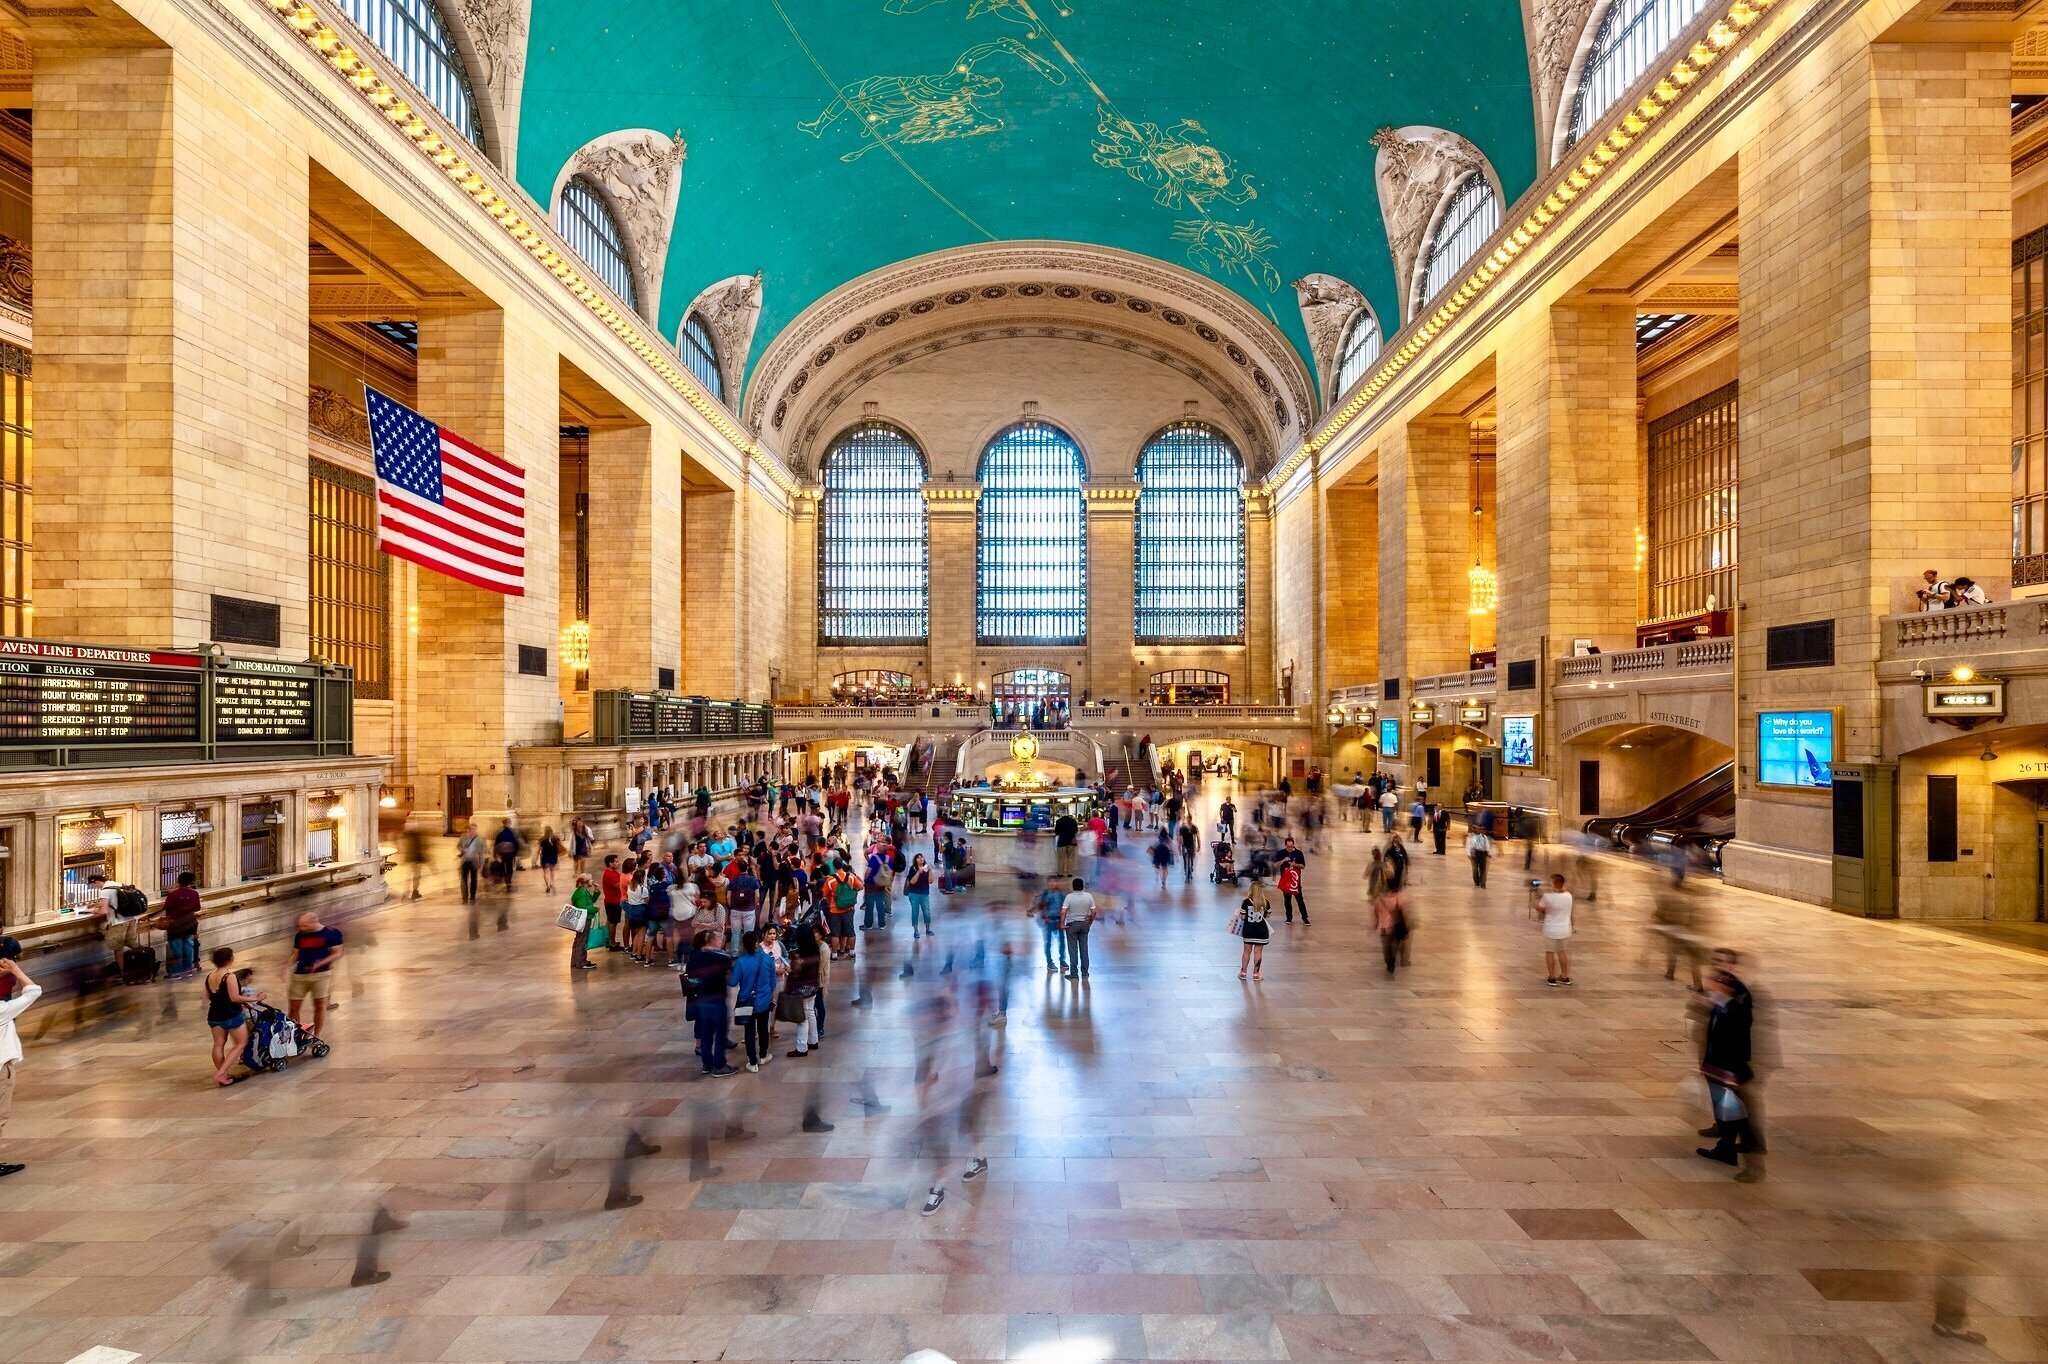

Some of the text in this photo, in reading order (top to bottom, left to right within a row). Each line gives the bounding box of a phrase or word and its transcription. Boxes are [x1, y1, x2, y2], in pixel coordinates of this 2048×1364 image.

[0, 641, 151, 663] AVEN LINE DEPARTURES
[0, 662, 95, 676] TION REMARKS
[235, 661, 297, 674] INFORMATION
[41, 678, 81, 688] HARRISON
[94, 681, 108, 689] 1ST
[110, 681, 129, 690] STOP
[215, 676, 229, 684] FREE
[41, 691, 67, 700] MOUNT
[70, 691, 99, 701] VERNON
[111, 693, 126, 702] 1ST
[127, 694, 145, 702] STOP
[215, 697, 239, 705] SERVICE
[41, 703, 81, 712] STAMFORD
[93, 704, 108, 712] 1ST
[110, 705, 129, 713] STOP
[42, 715, 86, 724] GREENWICH
[98, 716, 112, 724] 1ST
[114, 716, 133, 724] STOP
[1649, 711, 1701, 729] 45TH STREET
[1772, 718, 1813, 727] Why do you
[1560, 711, 1627, 740] THE METLIFE BUILDING
[1772, 726, 1824, 735] love the world?
[42, 728, 81, 736] STAMFORD
[94, 728, 108, 736] 1ST
[110, 728, 129, 736] STOP
[2018, 763, 2032, 773] 26
